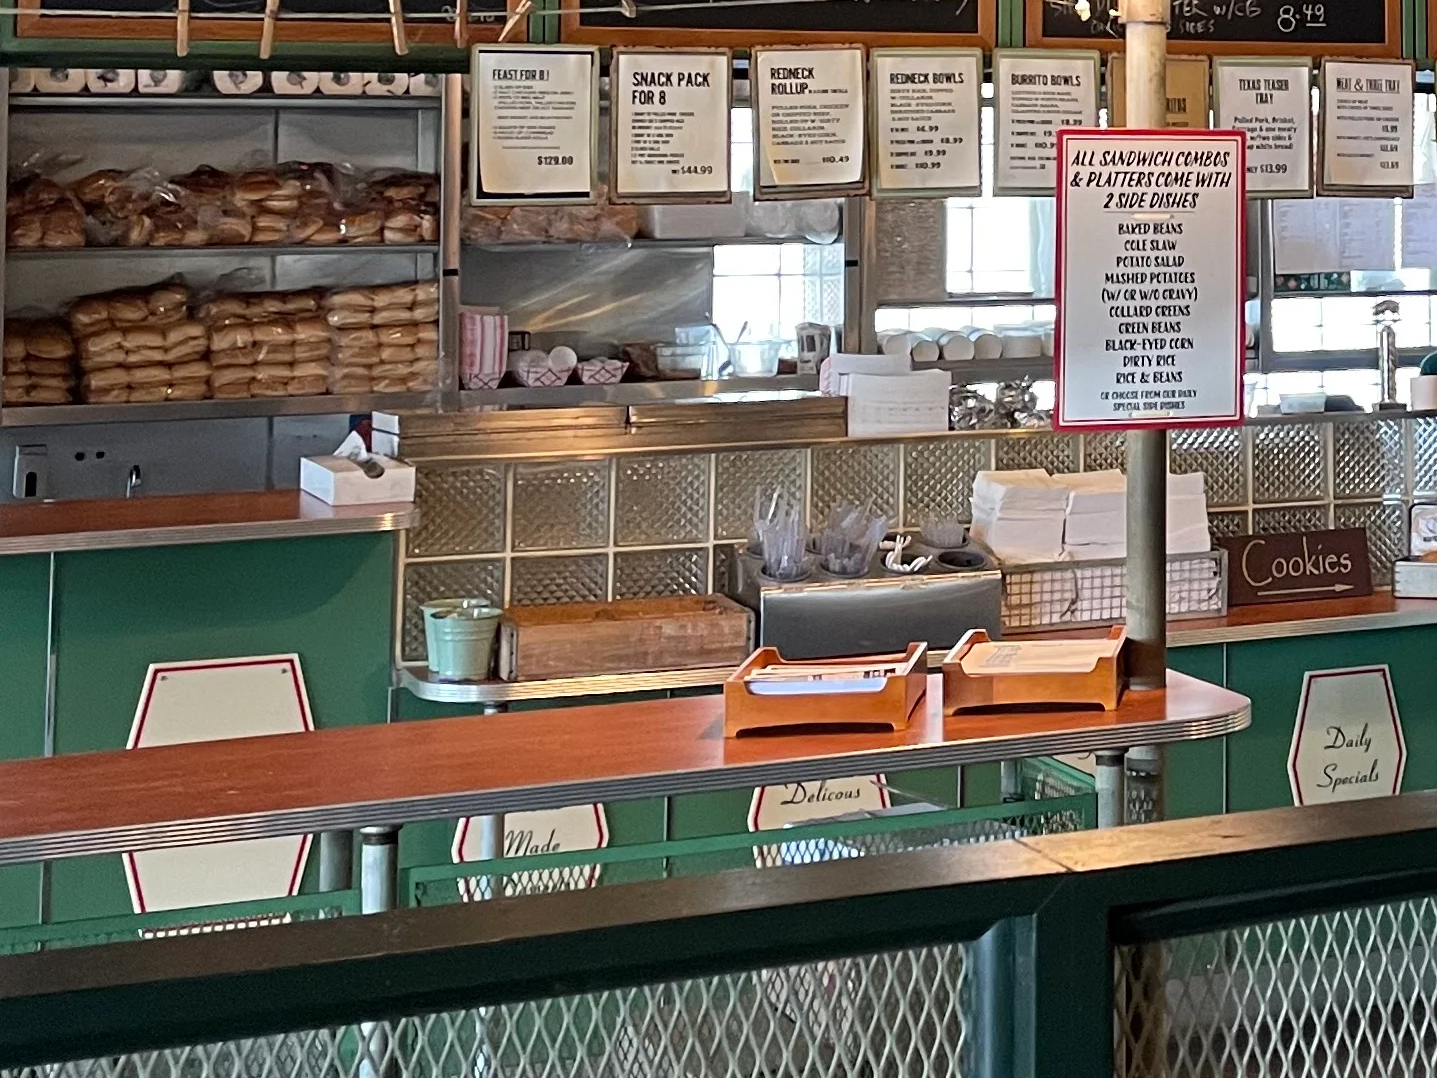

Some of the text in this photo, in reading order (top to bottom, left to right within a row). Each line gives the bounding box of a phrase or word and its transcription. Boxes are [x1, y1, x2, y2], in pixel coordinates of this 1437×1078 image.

[493, 69, 537, 81] FEAST FOR
[632, 72, 710, 88] SNACK PACK
[770, 67, 815, 80] REDNECK
[890, 73, 964, 85] REDNECK BOWLS
[1011, 74, 1081, 87] BURRITO BOWLS
[1239, 79, 1289, 91] TEXAS TEASER
[771, 82, 809, 95] ROLLUP
[632, 90, 666, 105] FOR 8
[1255, 93, 1274, 104] TRAY
[1071, 151, 1230, 167] ALL SANDWICH COMBOS
[1260, 164, 1287, 173] $13.99
[1070, 172, 1232, 188] & PLATTERS COME WITH
[1103, 192, 1199, 209] 2 SIDE DISHES
[1118, 223, 1183, 235] BAKED BEANS
[1124, 240, 1177, 252] COLE SLAW
[1116, 256, 1184, 268] POTATO SALAD
[1105, 272, 1195, 285] MASHED POTATOES
[1124, 289, 1137, 301] OR
[1109, 305, 1190, 318] COLLARD GREENS
[1118, 322, 1181, 334] GREEN BEANS
[1104, 338, 1194, 352] BLACK-EYED CORN
[1123, 355, 1176, 367] DIRTY RICE
[1116, 371, 1182, 384] RICE & BEANS
[1241, 539, 1352, 587] Cookies
[1324, 726, 1372, 753] Daily
[1317, 767, 1380, 792] Specials
[781, 780, 861, 805] Delicous
[506, 829, 560, 856] Made
